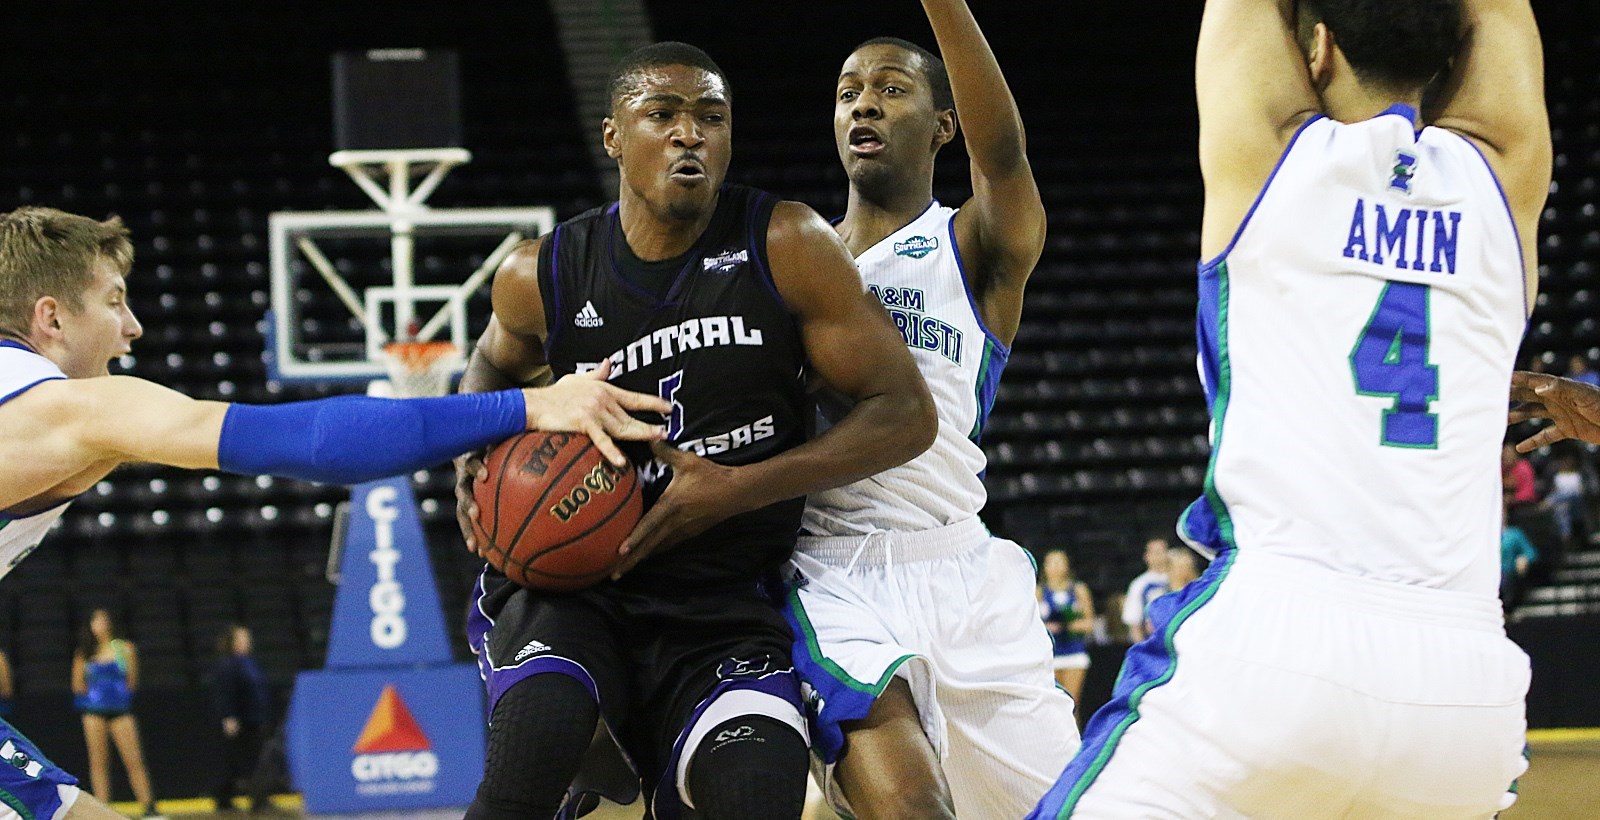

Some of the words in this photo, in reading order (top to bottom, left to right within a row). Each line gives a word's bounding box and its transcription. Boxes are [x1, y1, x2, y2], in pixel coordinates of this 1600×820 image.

[703, 249, 748, 270] SOUTHLAND
[895, 237, 938, 254] SOUTHLAND
[1342, 198, 1462, 275] AMIN
[574, 316, 604, 329] adidas
[889, 309, 964, 367] RISTI
[1348, 279, 1440, 450] 4
[658, 369, 684, 441] 5
[522, 431, 577, 477] CAA
[550, 459, 630, 524] ilson
[365, 486, 408, 649] CITGO
[514, 645, 552, 662] adidas
[351, 751, 440, 781] CITGO
